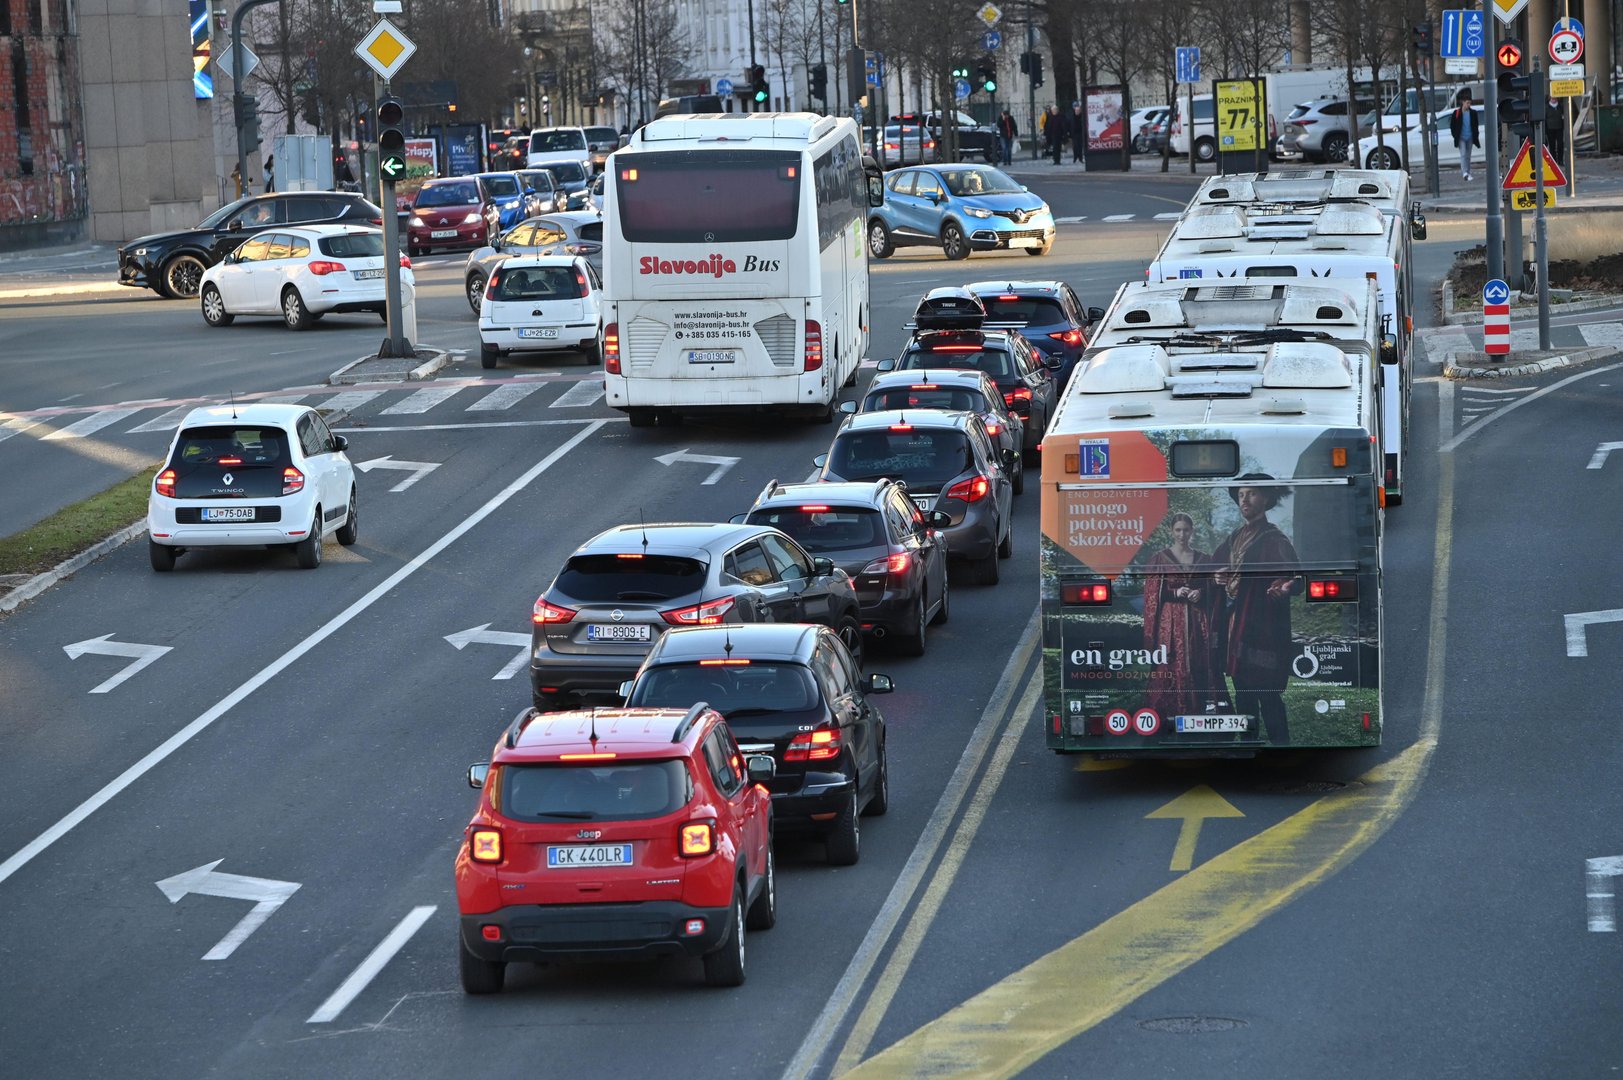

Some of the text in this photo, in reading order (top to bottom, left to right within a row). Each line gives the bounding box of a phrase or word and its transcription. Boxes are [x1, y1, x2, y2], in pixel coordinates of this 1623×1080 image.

[1088, 140, 1123, 150] SelectBO
[639, 253, 780, 278] Slavonija Bus
[674, 310, 747, 319] www.slavonija-bus.hr
[673, 321, 749, 330] info@slavonija-bus.hr
[524, 328, 532, 336] LJ
[721, 330, 751, 338] 415-165
[694, 352, 703, 360] SB
[208, 508, 253, 518] LJ 75-DAB
[1069, 503, 1127, 517] mnogo
[1069, 516, 1143, 533] potovanj
[1069, 532, 1143, 546] skozi čas
[594, 626, 646, 637] RI 8909-E
[1312, 645, 1351, 654] Ljubljanski
[1071, 644, 1168, 670] en grad
[1320, 652, 1336, 661] grad
[1071, 671, 1112, 679] MNOGO
[1112, 716, 1125, 728] 50
[1140, 716, 1153, 728] 70
[1184, 718, 1195, 729] LJ
[576, 829, 602, 840] Jeep
[558, 848, 622, 863] GK 440LR
